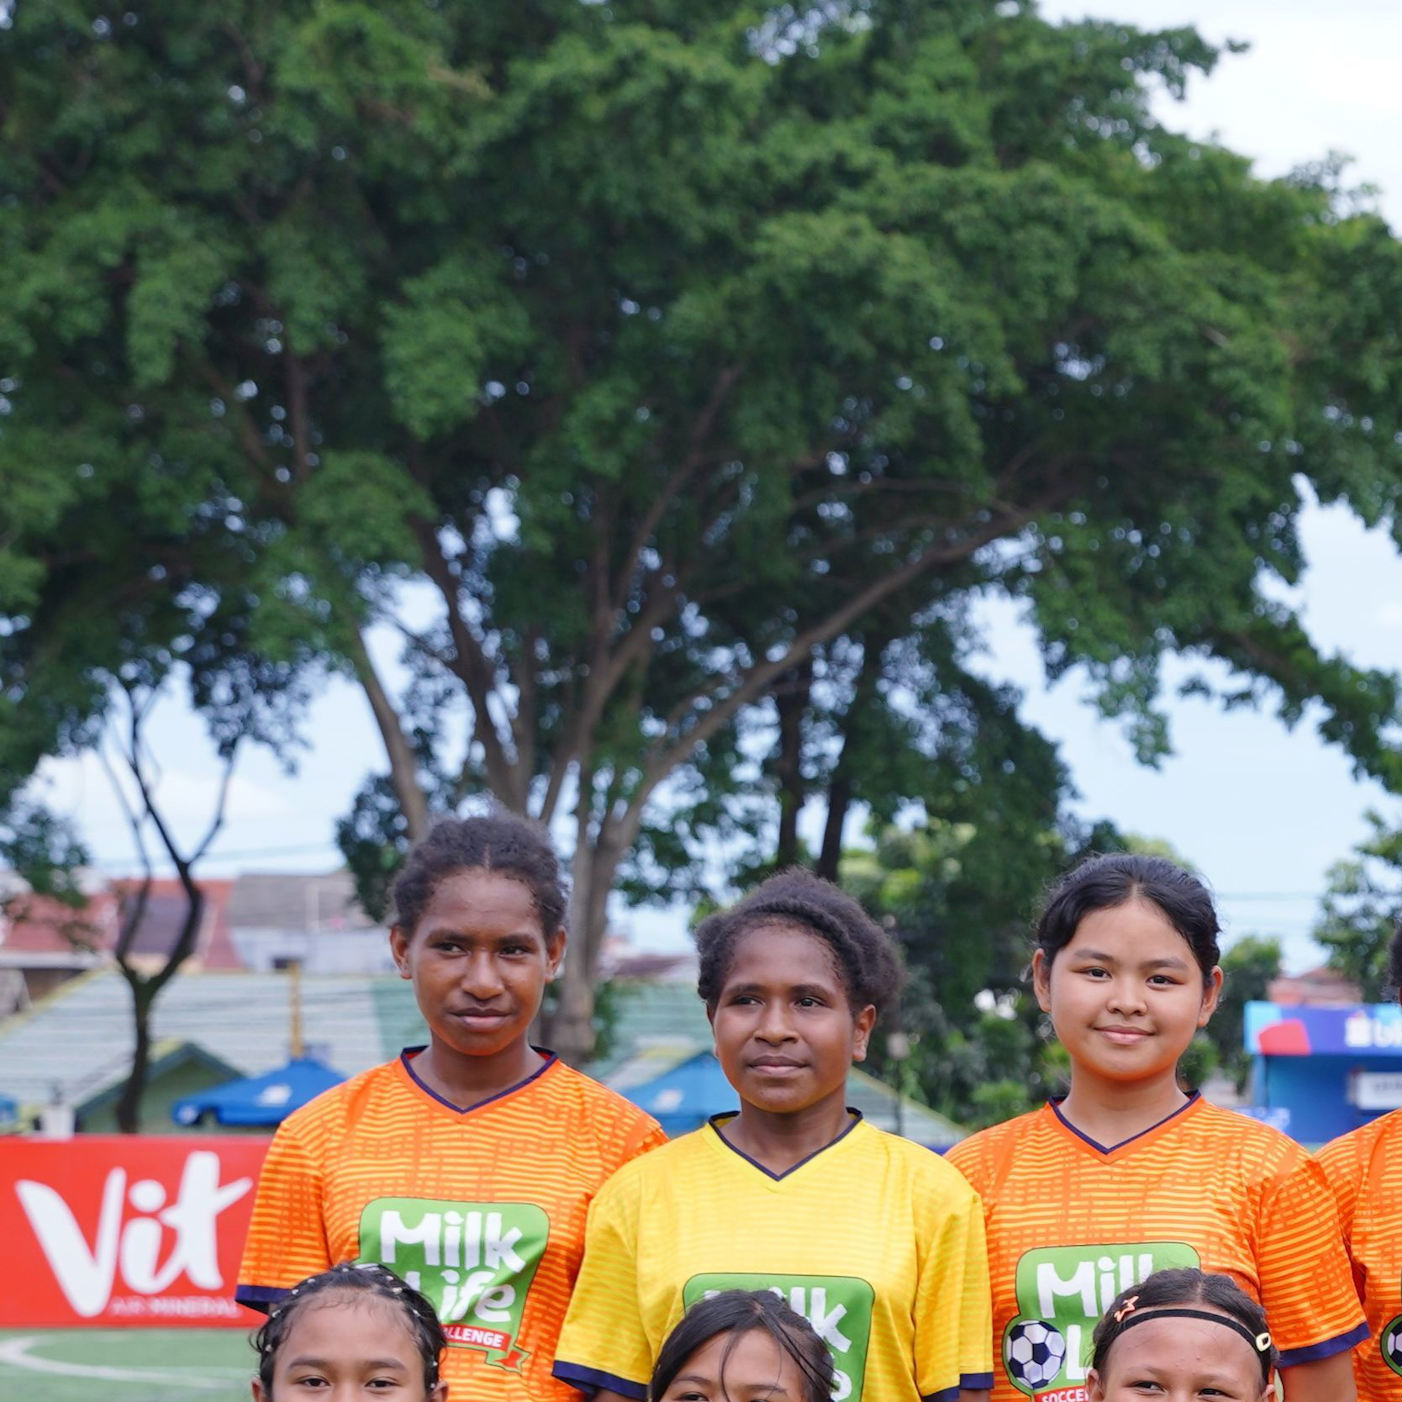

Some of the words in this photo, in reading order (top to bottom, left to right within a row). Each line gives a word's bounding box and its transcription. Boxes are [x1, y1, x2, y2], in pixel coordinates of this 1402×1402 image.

[15, 1150, 253, 1318] Vit
[380, 1211, 526, 1273] Milk
[406, 1269, 517, 1322] ife
